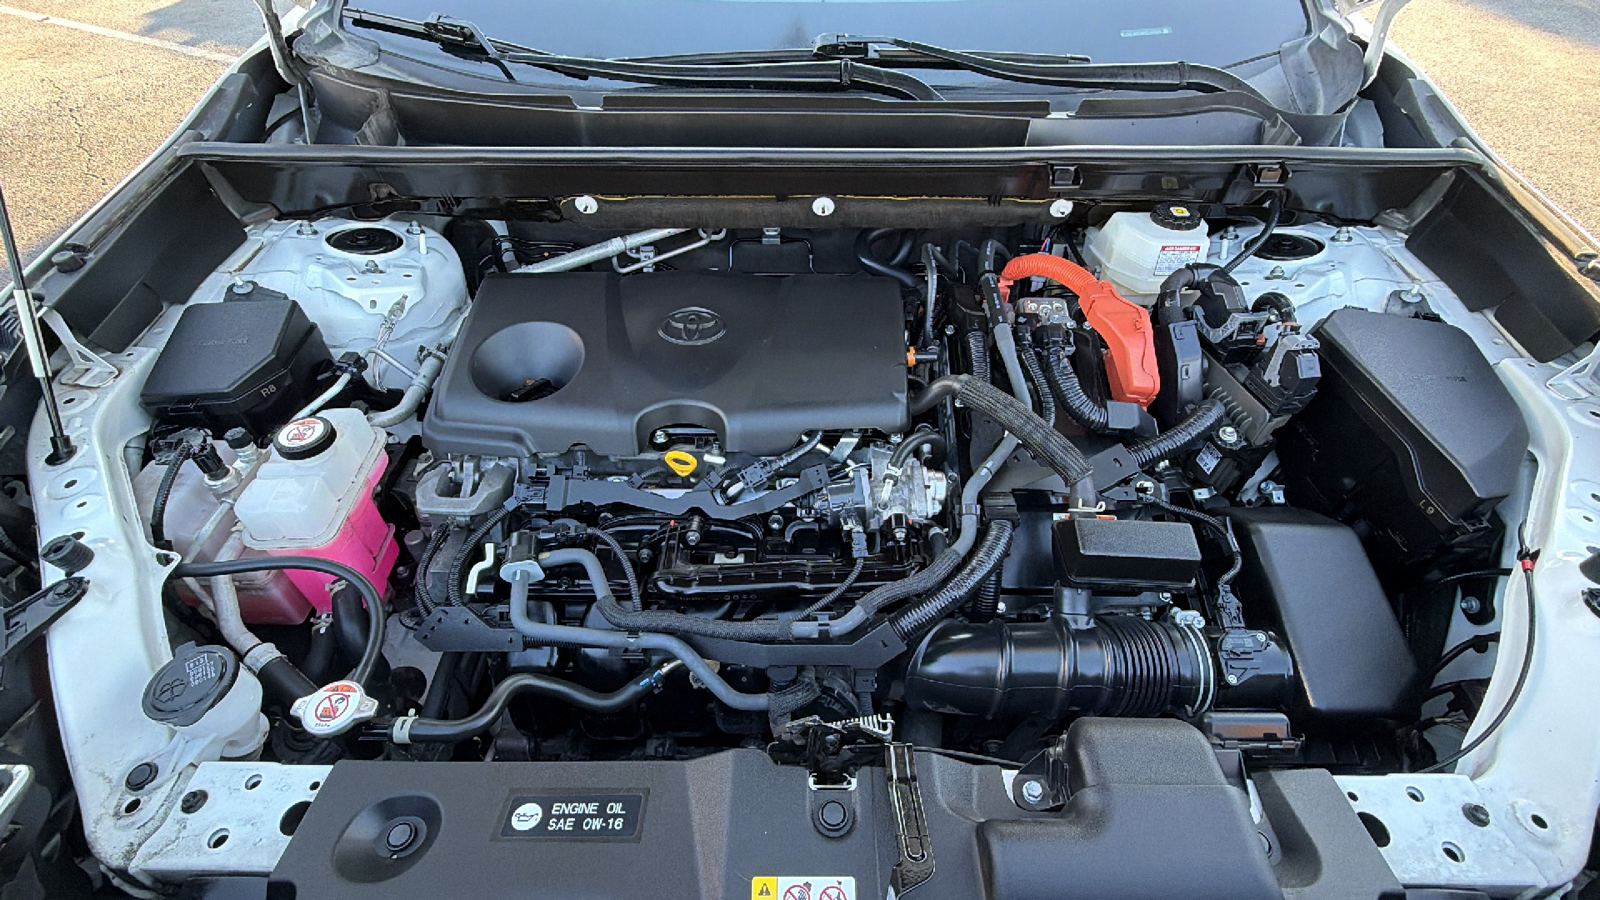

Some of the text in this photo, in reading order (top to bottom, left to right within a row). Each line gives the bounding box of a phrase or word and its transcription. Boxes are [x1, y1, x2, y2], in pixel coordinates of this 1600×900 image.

[260, 384, 277, 398] R8
[551, 802, 626, 815] ENGINE OIL
[547, 817, 624, 831] SAE 0W-16
